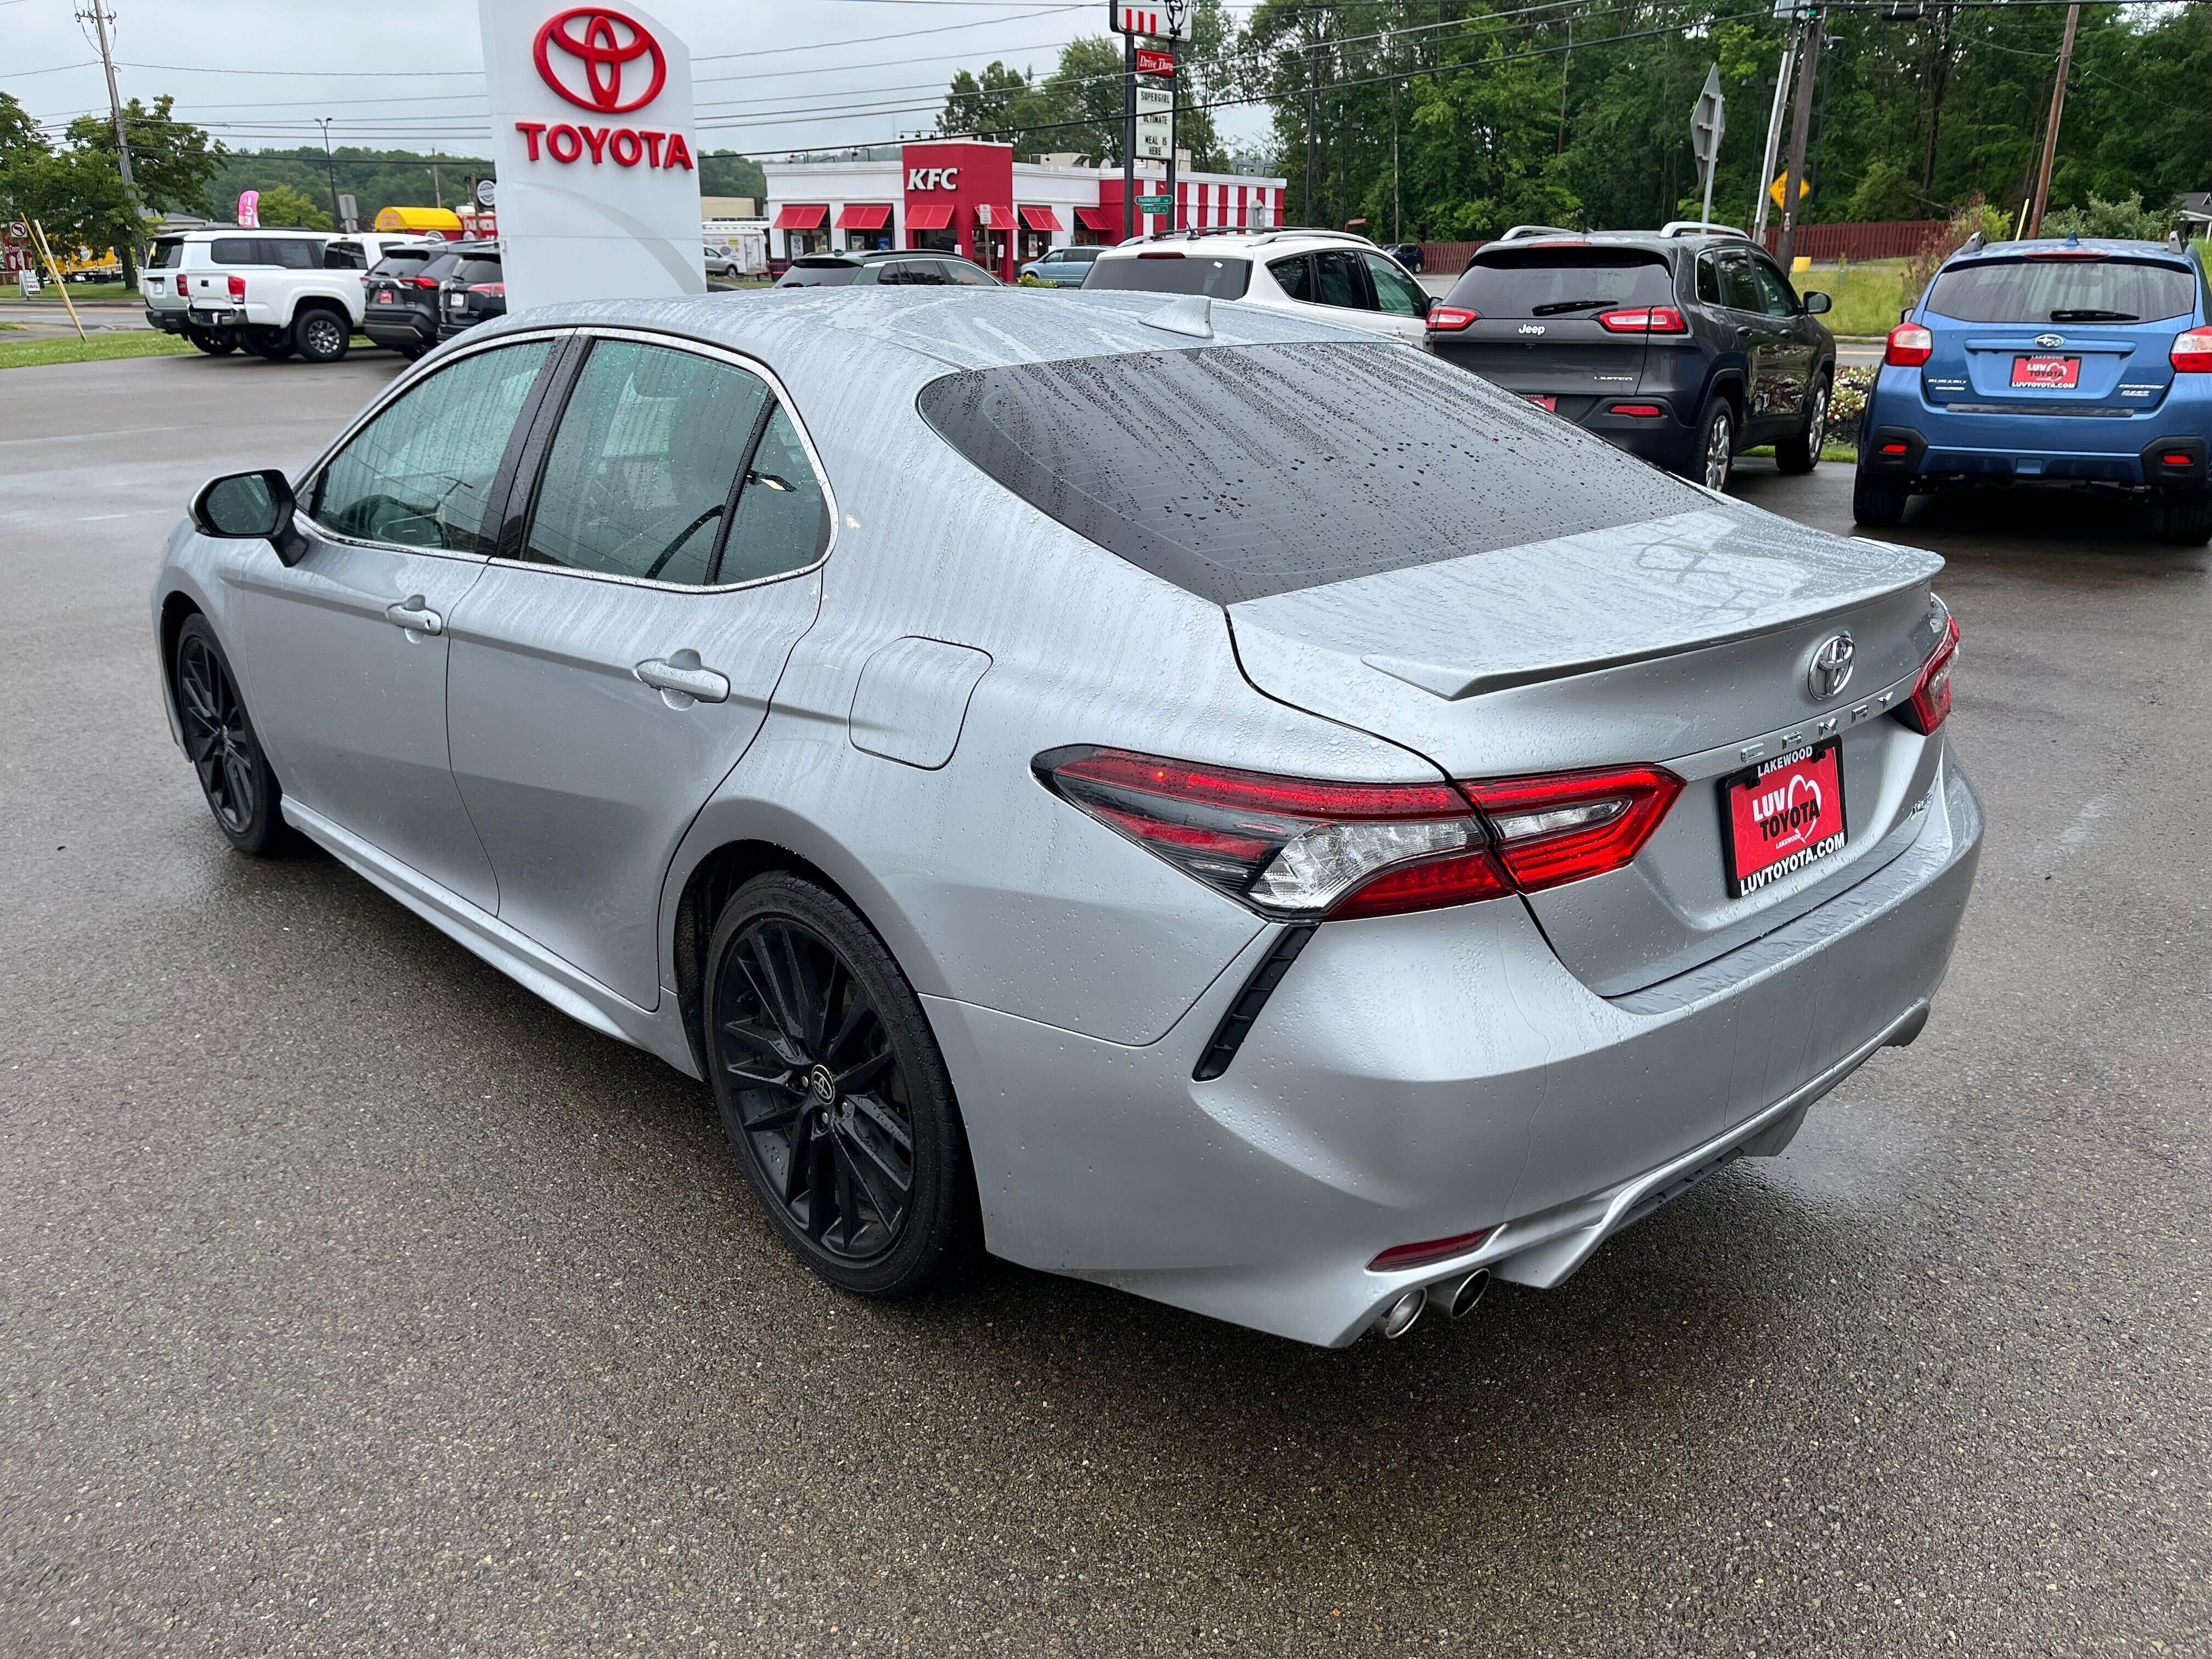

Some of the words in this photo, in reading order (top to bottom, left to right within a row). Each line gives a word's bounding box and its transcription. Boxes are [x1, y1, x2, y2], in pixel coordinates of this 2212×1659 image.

[1139, 55, 1156, 69] Drive
[1141, 92, 1170, 103] SUPERGIRL
[1143, 114, 1167, 125] ULTIMATE
[515, 121, 693, 170] TOYOTA
[1145, 136, 1158, 145] MEAL
[1163, 137, 1167, 145] IS
[1149, 146, 1161, 155] HERE
[906, 168, 958, 190] KFC
[1518, 324, 1545, 336] Jeep
[1741, 691, 1893, 762] CAMRY
[1757, 746, 1813, 777] LAKEWOOD
[1752, 787, 1786, 822] LUV
[1759, 798, 1821, 842] TOYOTA
[1775, 833, 1802, 850] LAKEWOOD
[1740, 832, 1846, 897] LUVTOYOTA.COM
